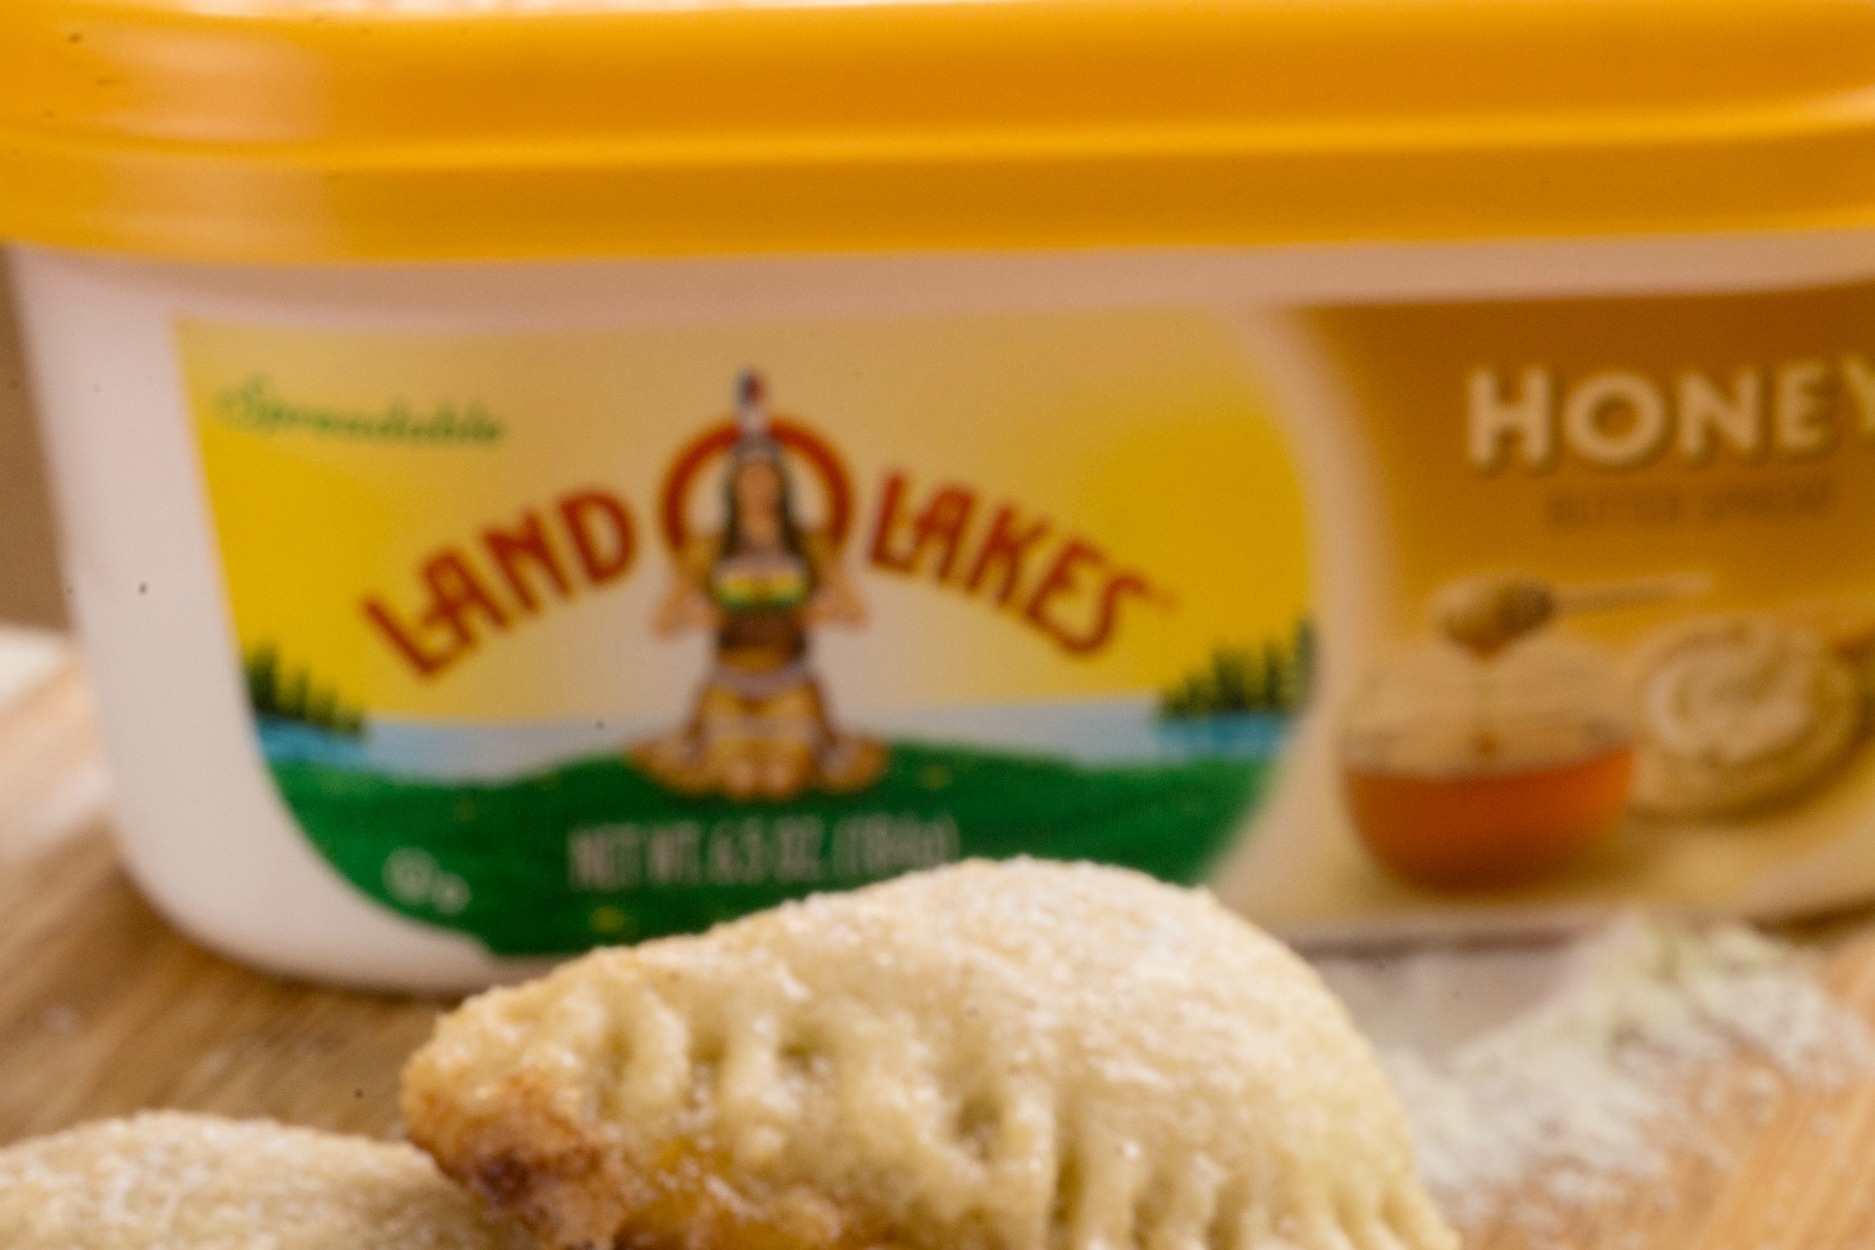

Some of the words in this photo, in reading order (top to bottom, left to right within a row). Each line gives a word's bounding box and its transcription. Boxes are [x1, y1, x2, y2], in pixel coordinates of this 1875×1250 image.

[359, 486, 637, 679] LAND
[866, 473, 1147, 657] LAKES
[568, 824, 643, 891] NET
